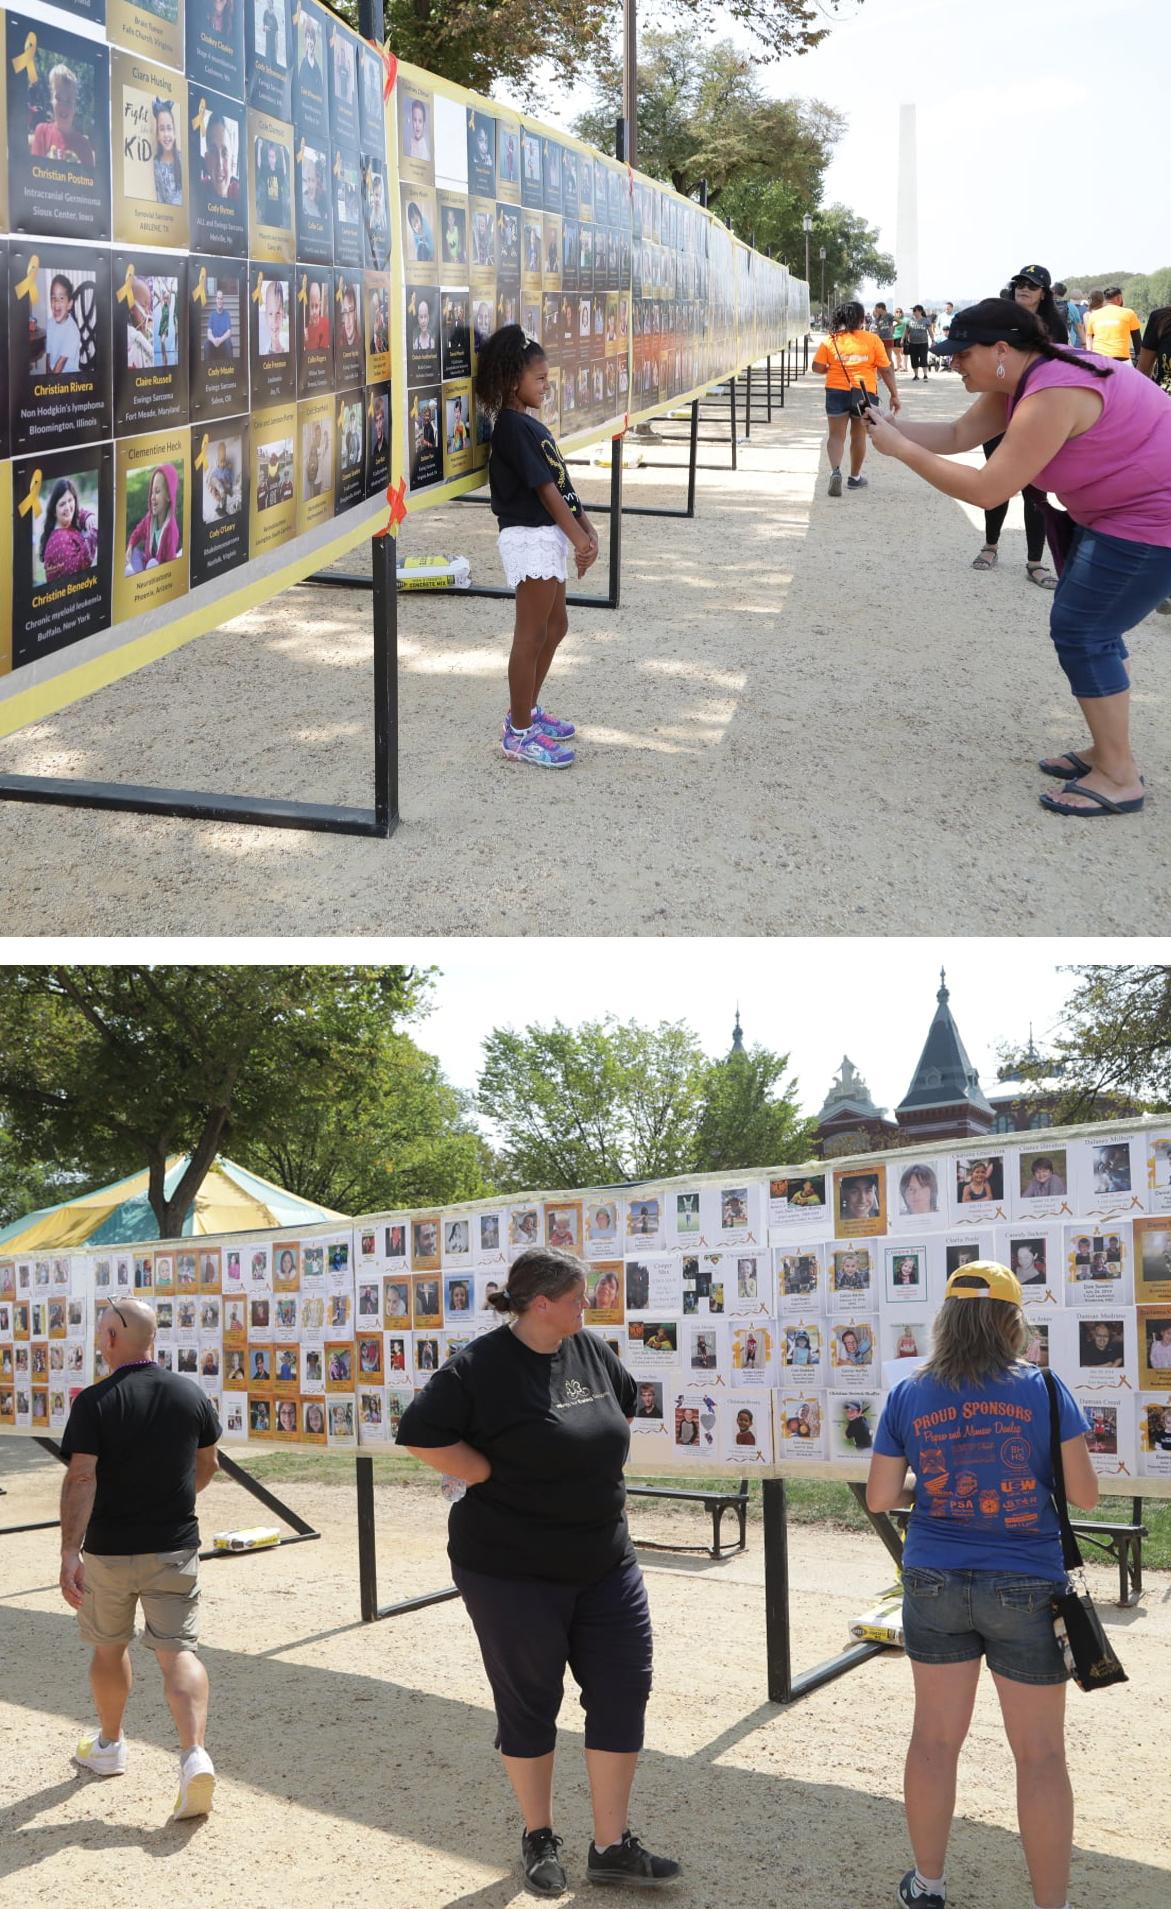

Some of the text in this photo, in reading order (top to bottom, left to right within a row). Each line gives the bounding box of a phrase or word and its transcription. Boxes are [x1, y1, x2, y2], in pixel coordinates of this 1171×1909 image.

[132, 67, 172, 93] Ciara Husing
[32, 166, 94, 186] Christian Postma
[24, 186, 64, 201] Intracranial
[33, 206, 94, 222] Sioux Center, Iowa
[34, 381, 94, 396] Christian Rivera
[135, 374, 172, 387] Claire Russell
[20, 401, 105, 419] Non Hodgkin's lymphoma
[125, 412, 137, 421] Fort
[29, 417, 97, 435] Bloomington, Illinois
[128, 441, 182, 460] Clementine Heck
[32, 575, 98, 608] Christine Benedyk
[25, 614, 51, 631] Chronic
[51, 603, 75, 621] myeloid
[37, 612, 91, 642] Buffalo, New York
[912, 1400, 1033, 1437] PROUD SPONSORS
[950, 1500, 974, 1509] PSA
